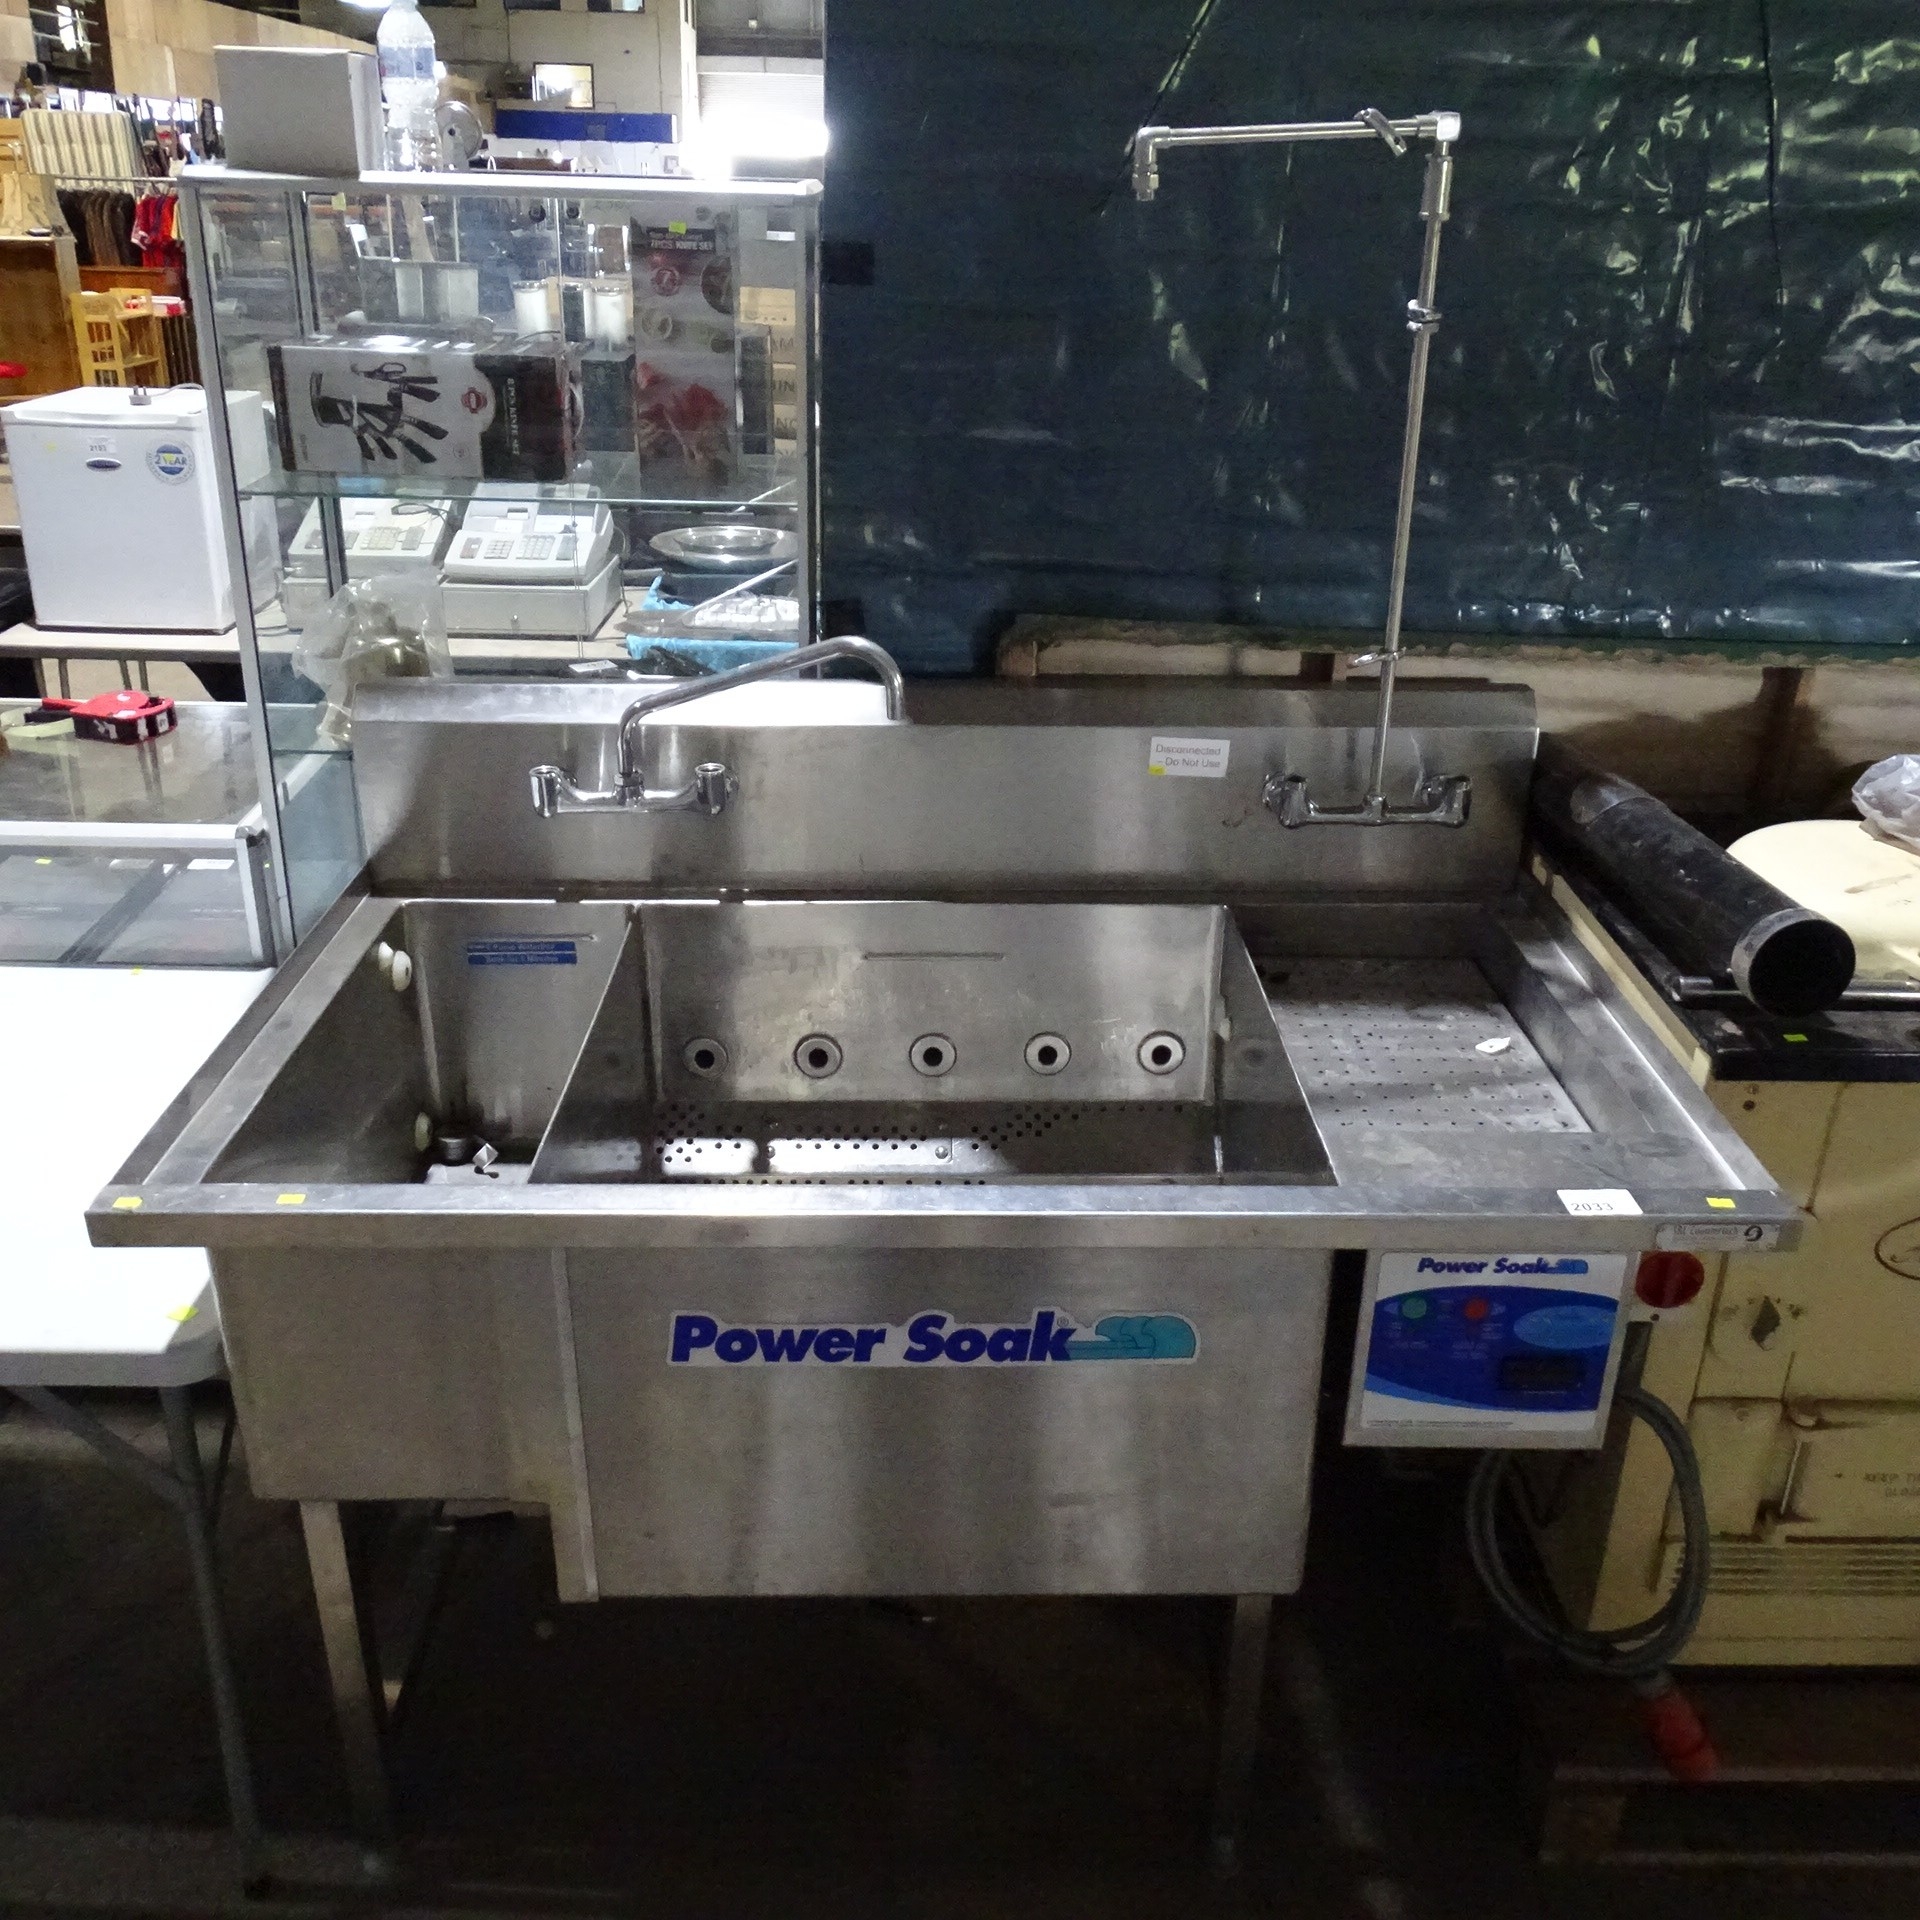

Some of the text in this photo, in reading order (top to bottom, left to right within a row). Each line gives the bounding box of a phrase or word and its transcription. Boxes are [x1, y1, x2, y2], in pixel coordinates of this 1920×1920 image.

[162, 454, 188, 466] YEAR
[1155, 743, 1222, 756] Disconnected
[1165, 756, 1180, 767] Do
[1181, 758, 1199, 768] Not
[1201, 759, 1221, 769] Use
[1570, 1202, 1615, 1212] 2033
[1417, 1257, 1550, 1274] Power Soak
[671, 1310, 1078, 1363] Power Soak
